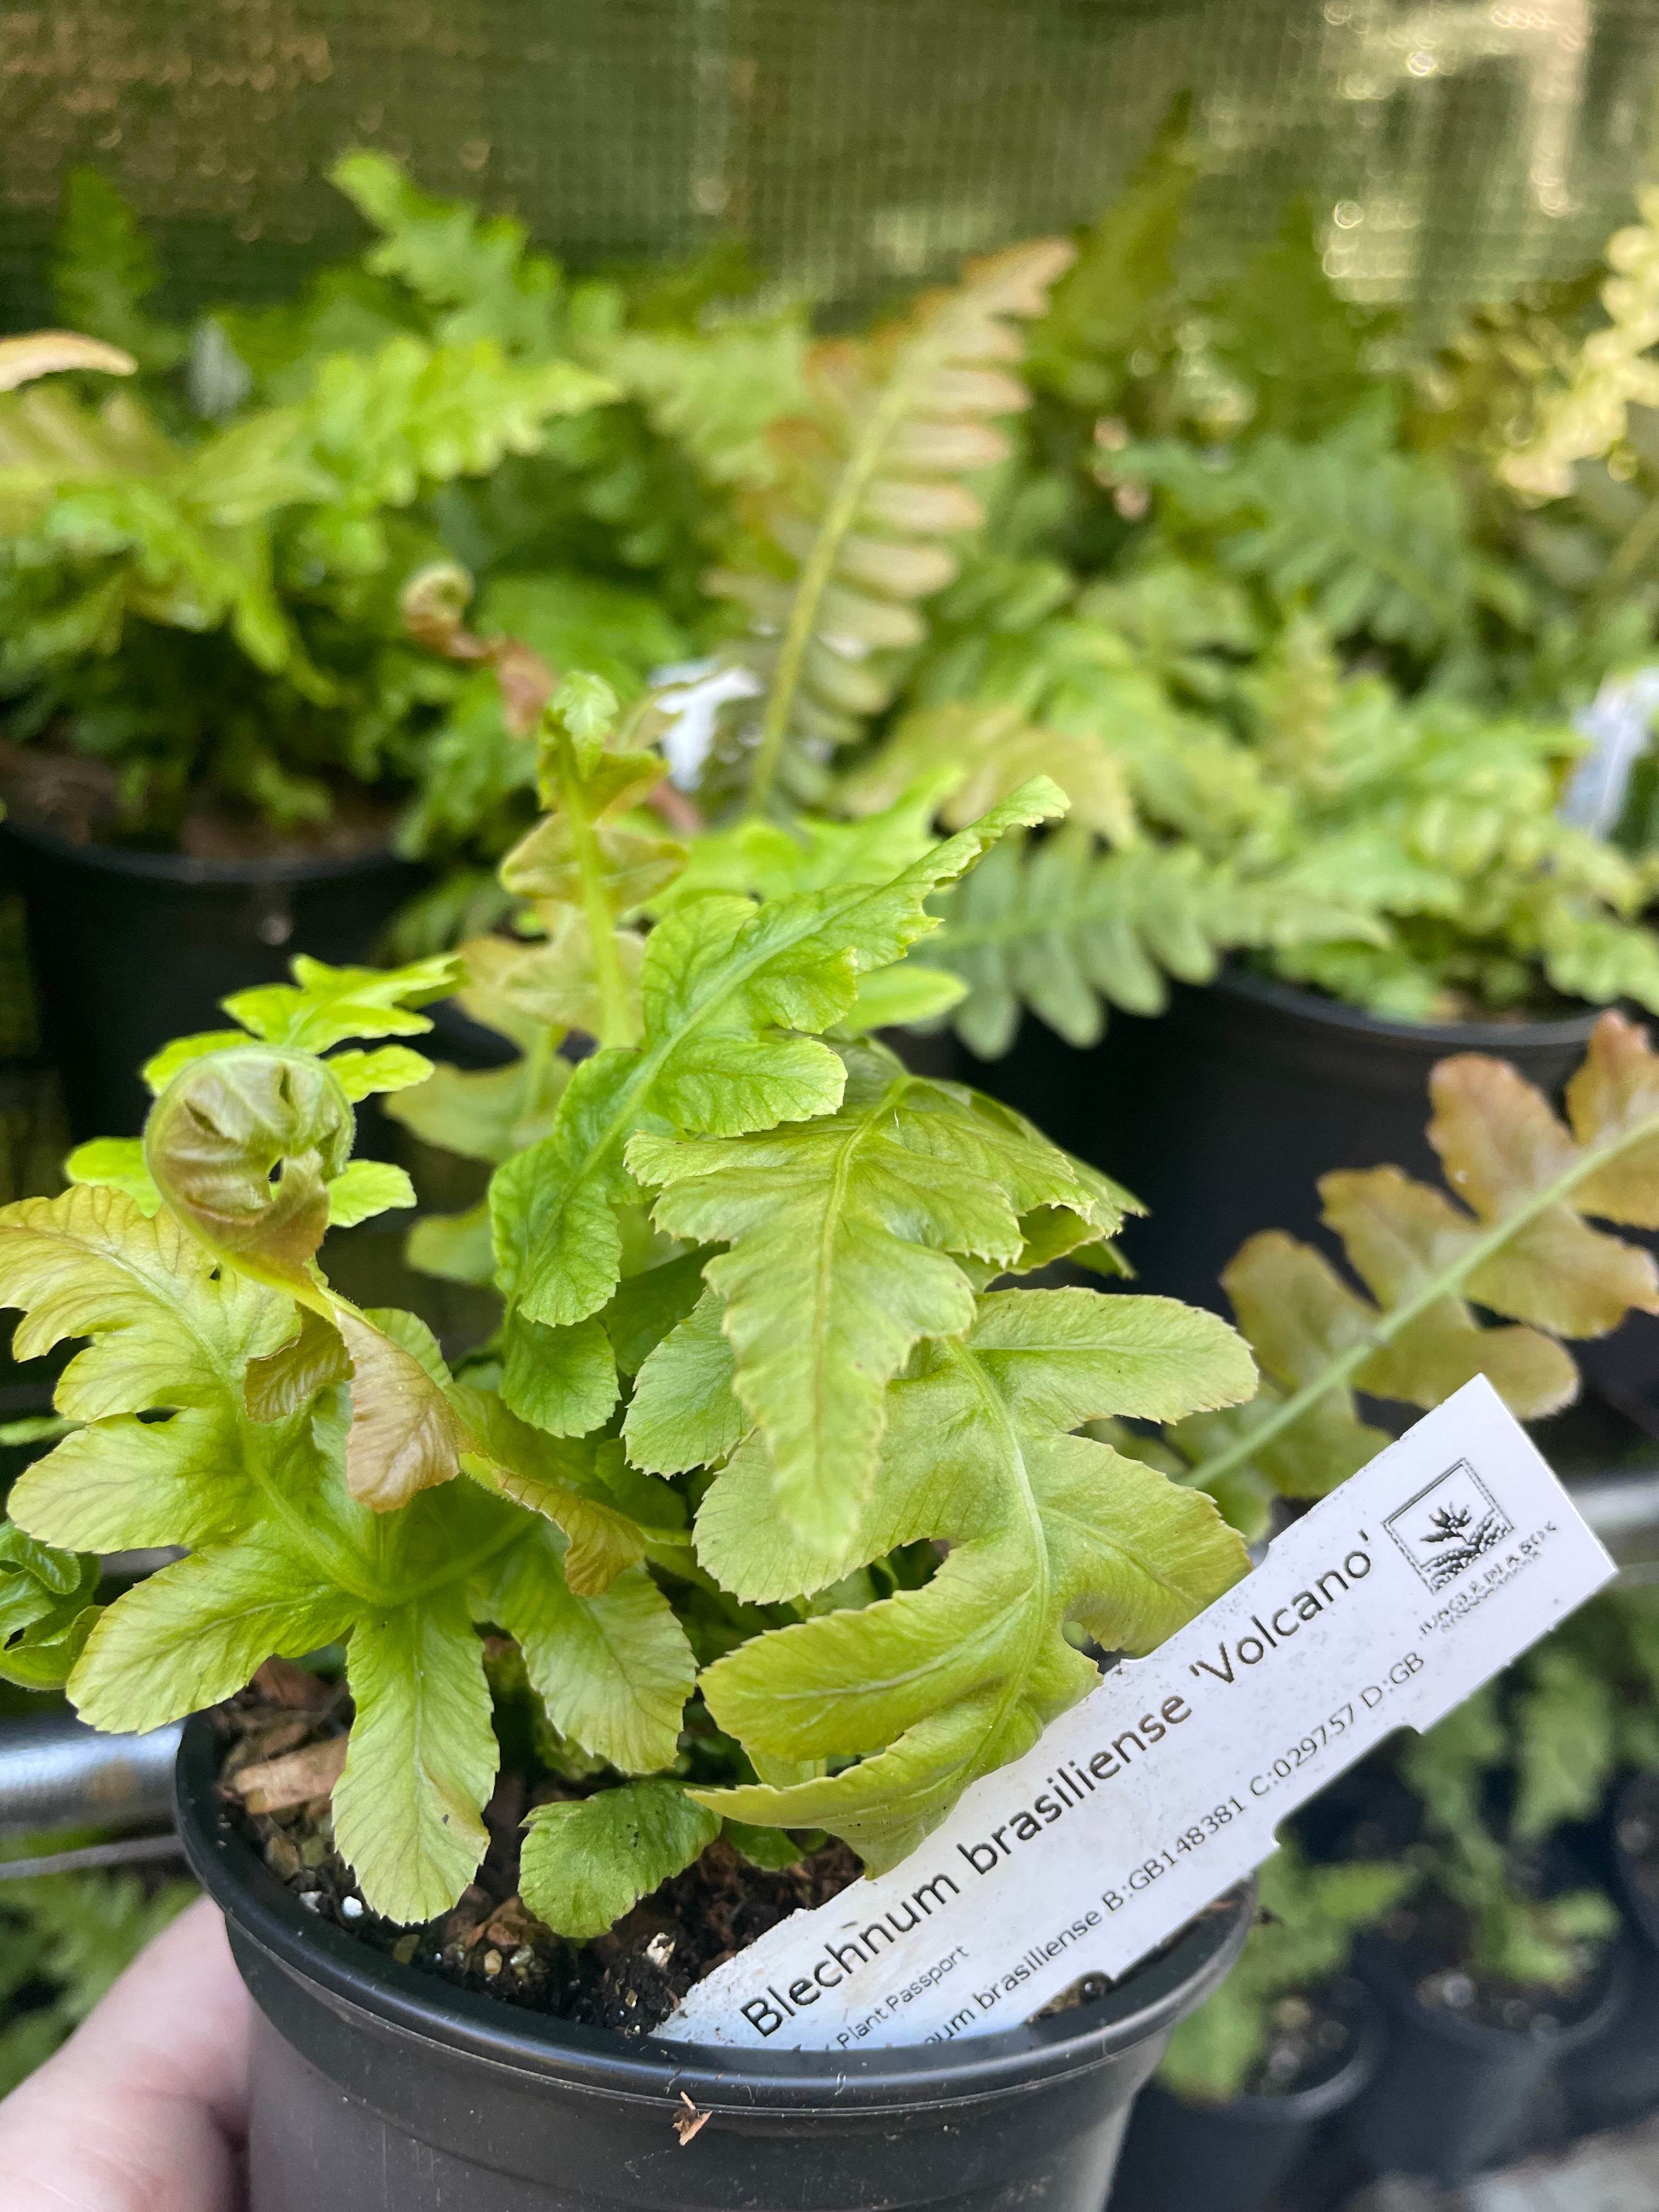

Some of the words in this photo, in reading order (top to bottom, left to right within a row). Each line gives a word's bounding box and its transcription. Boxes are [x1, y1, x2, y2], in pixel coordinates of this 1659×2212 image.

[740, 1872, 961, 2038] Blechnum
[956, 1695, 1193, 1875] brasiliense
[1188, 1528, 1372, 1684] 'Volcano'
[972, 1909, 1103, 2010] brasiliense
[1102, 1794, 1247, 1911] B:GB148381
[1249, 1702, 1355, 1798] C:029757
[1359, 1651, 1425, 1709] D:GB
[836, 2007, 889, 2049] Plant
[885, 1945, 970, 2012] Passport
